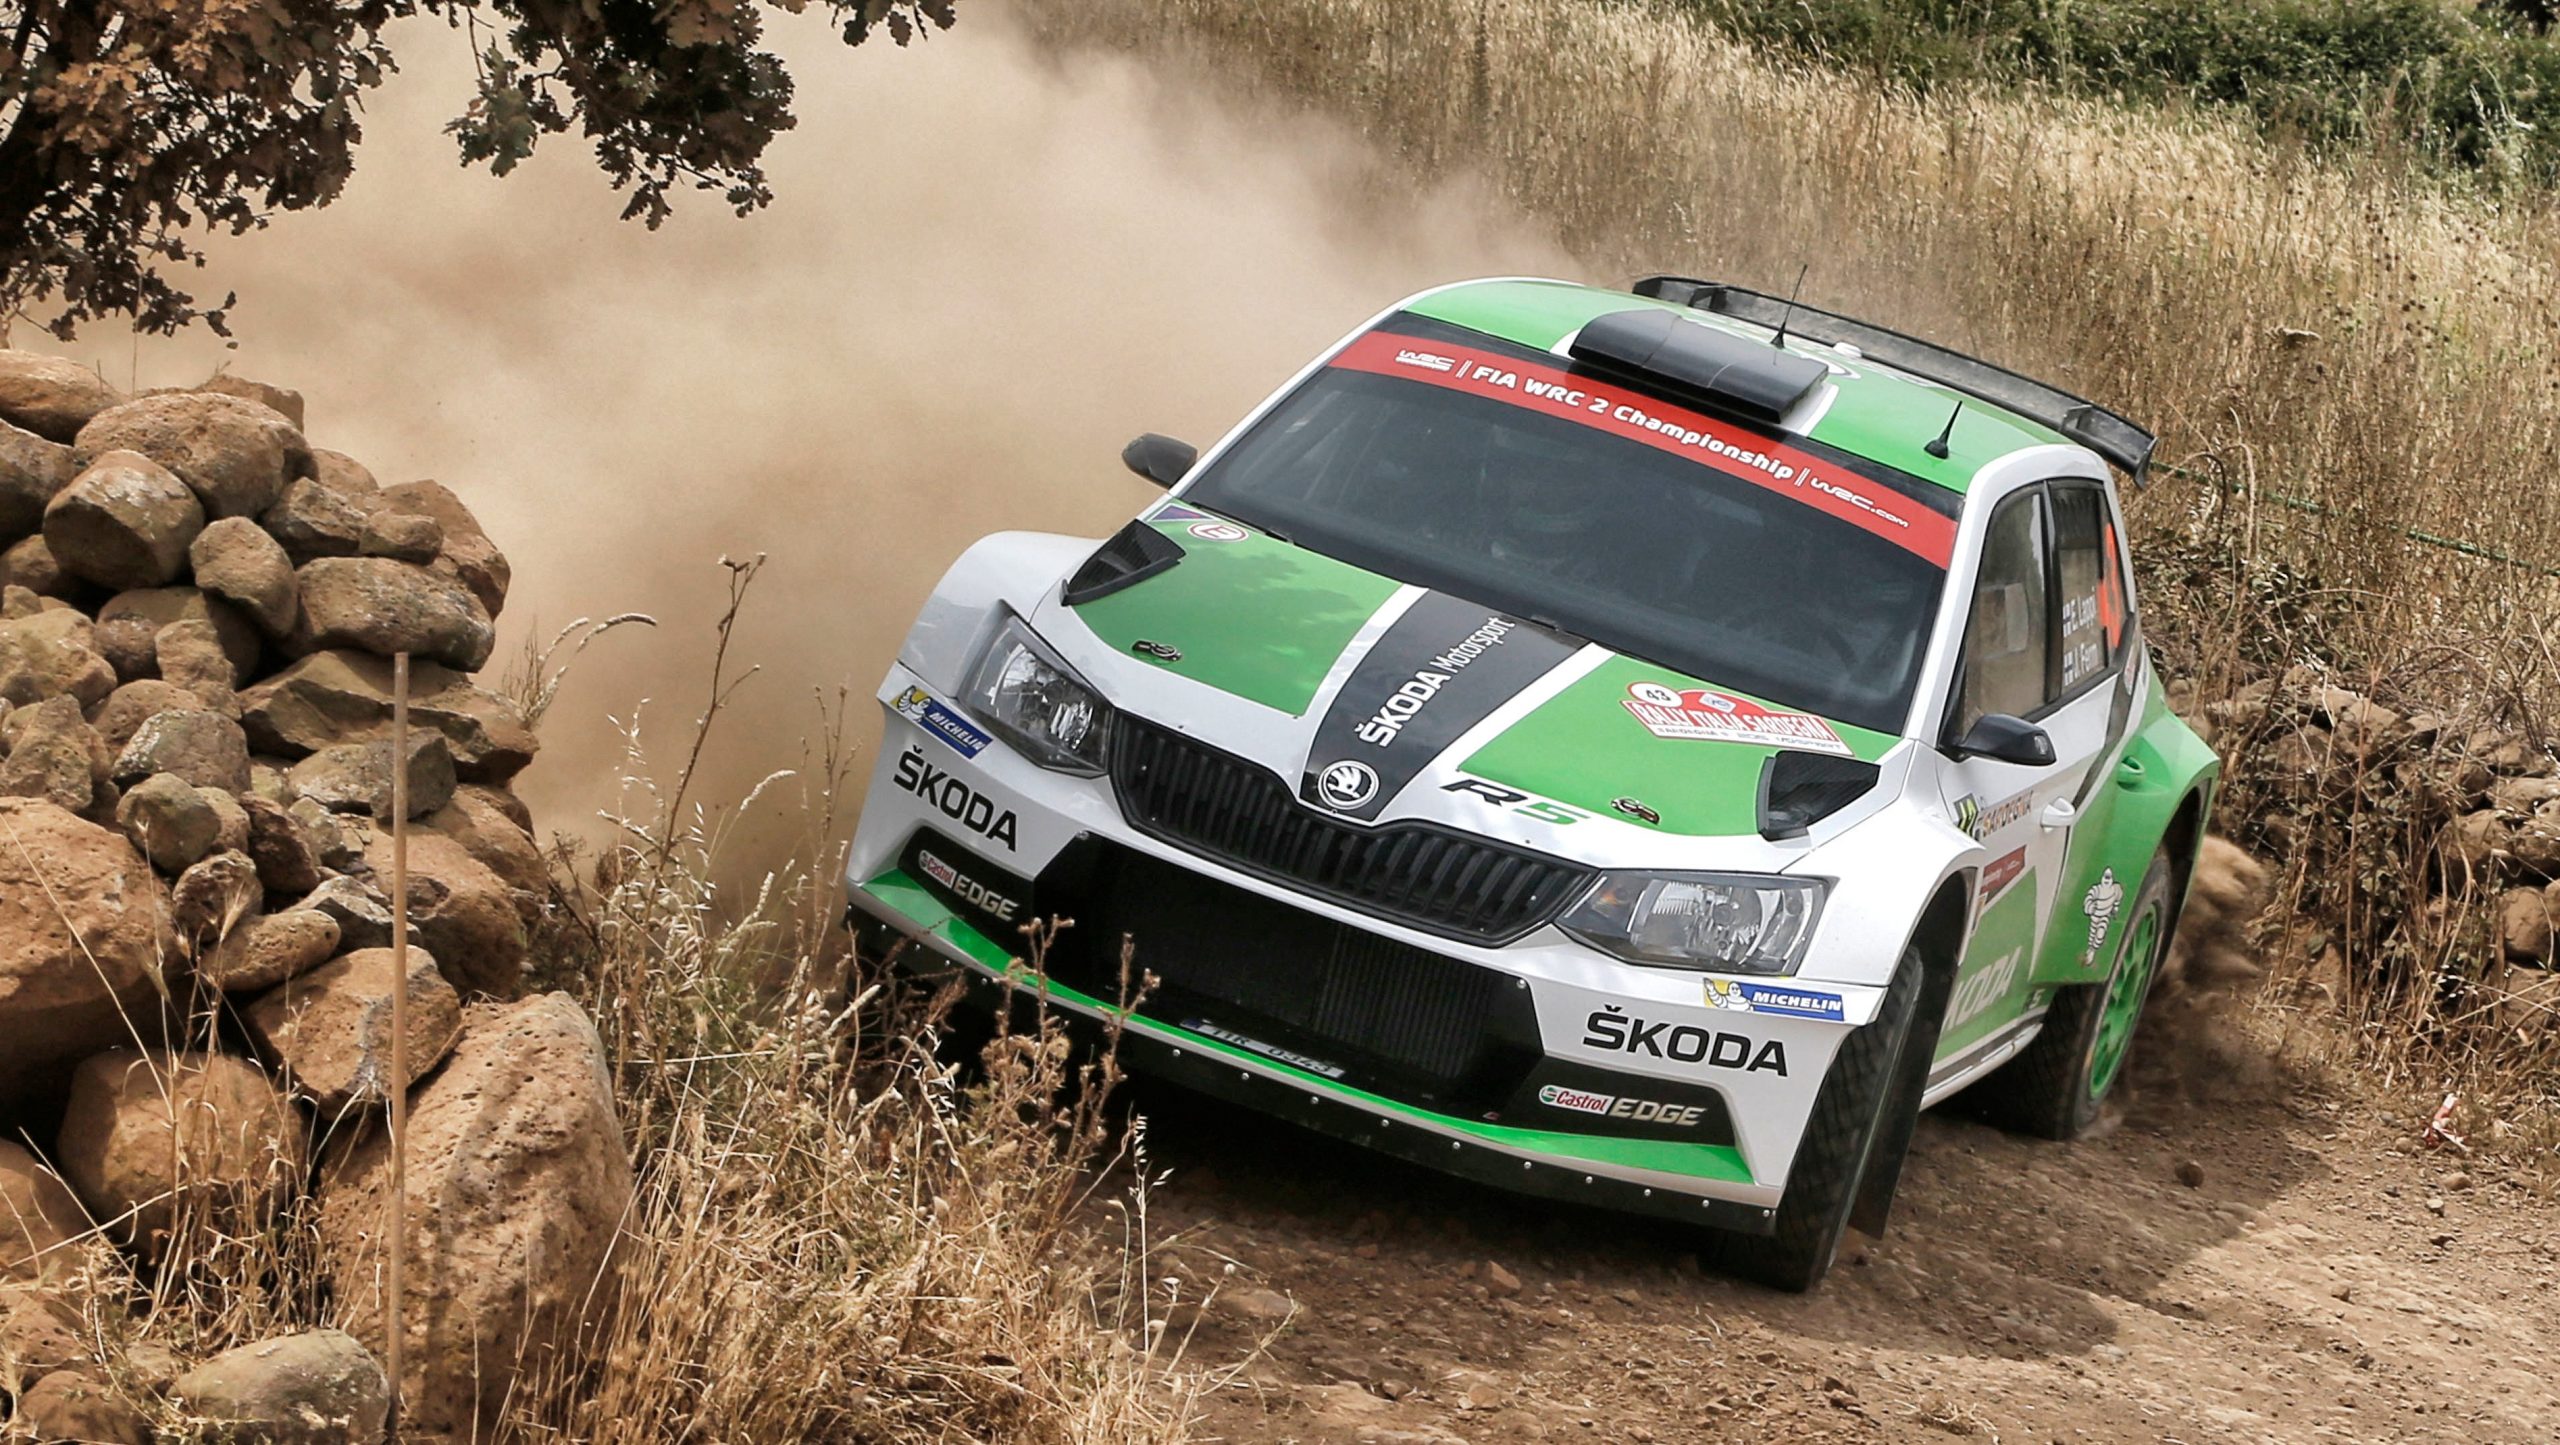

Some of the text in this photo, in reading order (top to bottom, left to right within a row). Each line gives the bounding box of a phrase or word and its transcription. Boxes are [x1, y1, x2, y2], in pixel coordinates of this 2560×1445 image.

[1472, 366, 1517, 389] FIA
[1524, 378, 1585, 407] WRC
[1588, 398, 1610, 413] 2
[1613, 405, 1795, 481] Championship
[1354, 616, 1516, 748] ŠKODA Motorsport
[1645, 689, 1671, 702] 43
[928, 711, 986, 750] MICHELIN
[1633, 703, 1840, 742] RALLY ITALIA SARDEGNA
[893, 745, 1017, 852] ŠKODA
[1440, 779, 1591, 825] R5
[953, 876, 1020, 922] EDGE
[1752, 990, 1842, 1011] MICHELIN
[1942, 946, 2023, 1032] KODA
[1582, 1004, 1788, 1077] ŠKODA
[1556, 1090, 1707, 1127] Castrol EDGE
